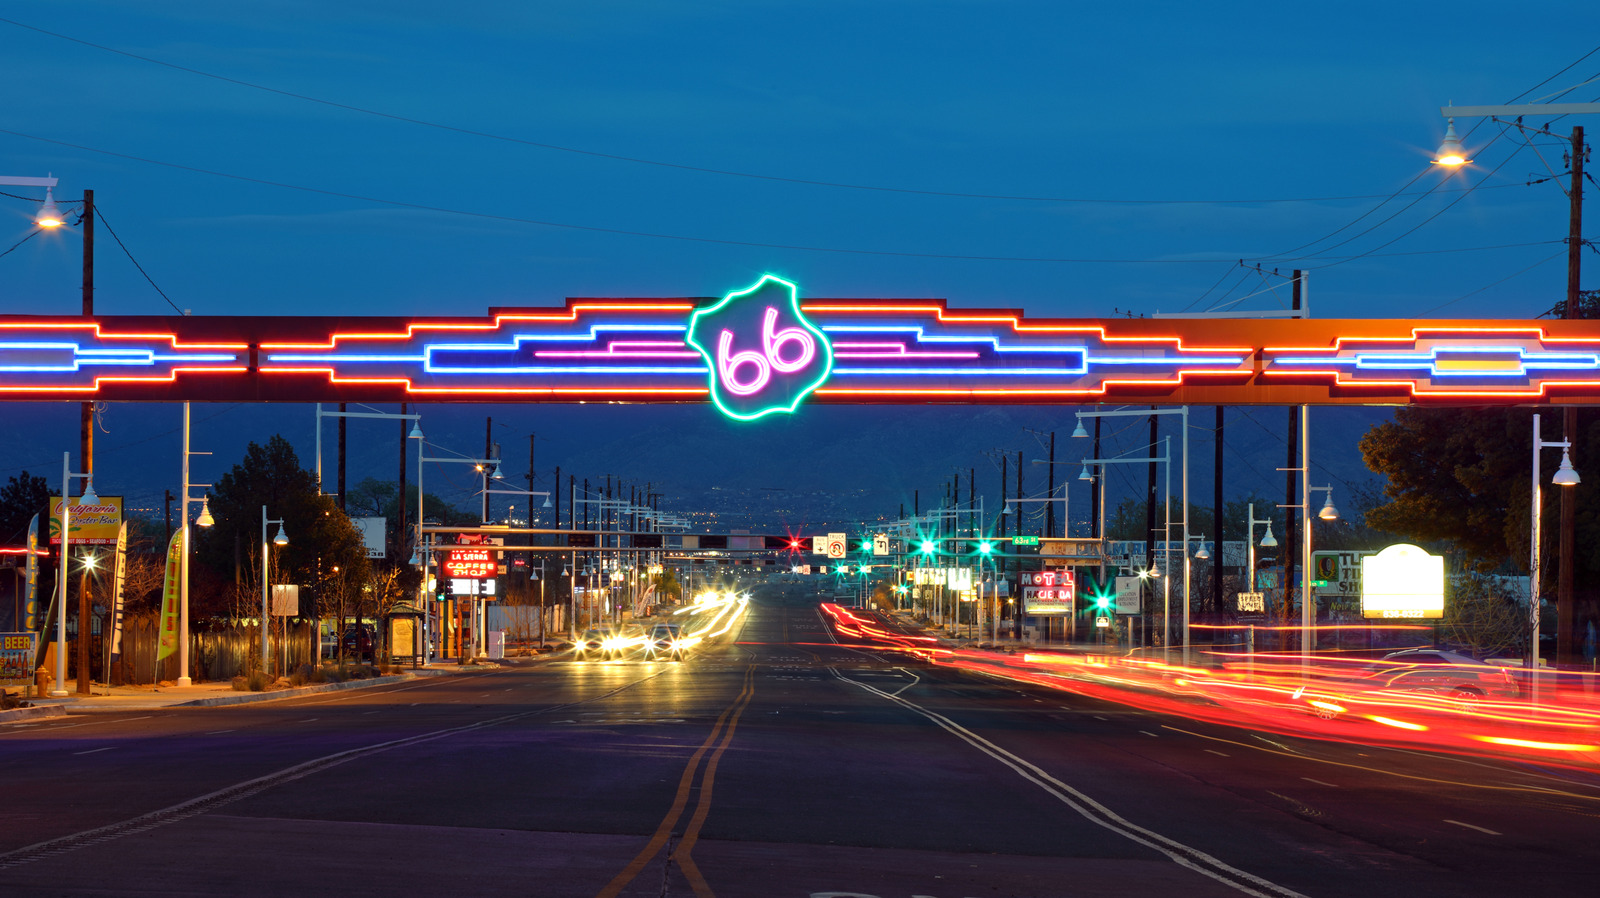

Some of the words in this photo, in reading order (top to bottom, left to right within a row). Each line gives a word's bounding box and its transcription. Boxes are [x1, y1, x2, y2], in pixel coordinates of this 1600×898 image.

[717, 304, 816, 396] 66
[55, 499, 118, 516] California
[69, 515, 98, 527] Oyster
[99, 515, 118, 525] Bar
[446, 562, 494, 570] COFFEE
[1021, 572, 1074, 586] MOTEL
[1026, 590, 1072, 599] HACIENDA
[5, 636, 30, 650] BEER
